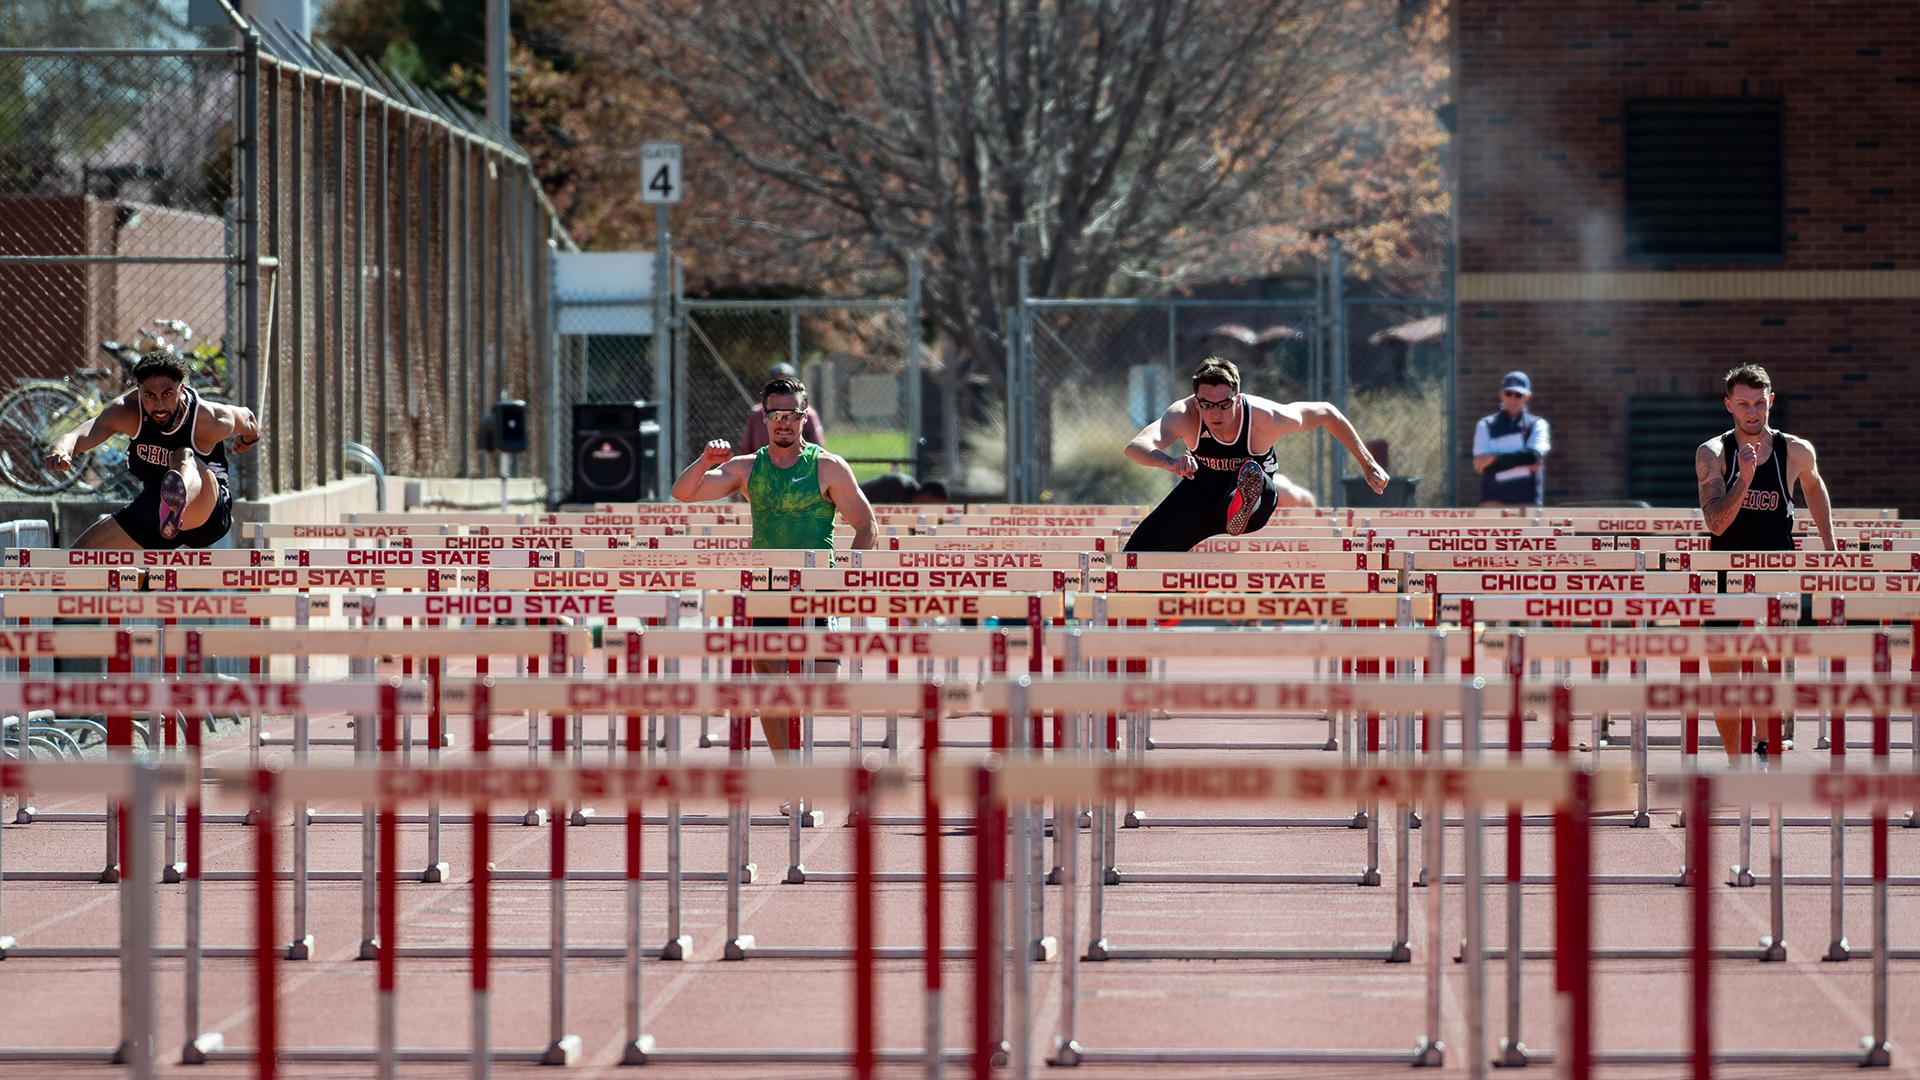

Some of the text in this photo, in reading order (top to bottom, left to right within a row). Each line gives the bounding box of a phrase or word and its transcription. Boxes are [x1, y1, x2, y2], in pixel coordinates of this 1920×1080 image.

[649, 163, 674, 197] 4
[137, 444, 174, 466] CHI
[1741, 489, 1779, 511] HICO
[637, 505, 733, 514] CHICO STATE
[874, 506, 921, 514] STATE
[1380, 510, 1475, 518] CHICO STATE
[585, 515, 689, 525] CHICO STATE
[990, 517, 1095, 526] CHICO STATE
[1598, 520, 1704, 530] CHICO STATE
[294, 526, 408, 537] CHICO STATE
[519, 527, 635, 535] CHICO STATE
[967, 527, 1082, 536] CHICO STATE
[1407, 529, 1522, 537] CHICO STATE
[446, 537, 573, 549] CHICO STATE
[693, 537, 751, 549] CHICO
[1248, 540, 1309, 552] STATE
[1428, 538, 1556, 550] CHICO STATE
[1675, 538, 1711, 550] CHI
[69, 551, 212, 565] CHICO STATE
[347, 550, 490, 565] CHICO STATE
[899, 552, 1042, 567] CHICO STATE
[1452, 553, 1597, 568] CHICO STATE
[1730, 553, 1873, 568] CHICO STATE
[0, 571, 66, 586] TATE
[222, 570, 385, 586] CHICO STATE
[534, 571, 696, 587] CHICO STATE
[844, 571, 1007, 588] CHICO STATE
[1162, 573, 1325, 589] CHICO STATE
[1481, 574, 1645, 591] CHICO STATE
[1801, 575, 1875, 591] CHICO
[57, 596, 247, 614] CHICO STATE
[426, 595, 614, 614] CHICO STATE
[790, 596, 978, 614] CHICO STATE
[1158, 598, 1347, 615] CHICO STATE
[1526, 599, 1715, 616] CHICO STATE
[705, 632, 930, 653] CHICO STATE
[1585, 633, 1812, 655] CHICO STATE
[22, 681, 302, 708] CHICO STATE
[567, 682, 847, 709] CHICO STATE
[1122, 683, 1256, 709] CHICO
[1646, 683, 1774, 710] CHICO
[381, 767, 749, 799] CHICO STATE
[1100, 768, 1468, 799] CHICO STATE
